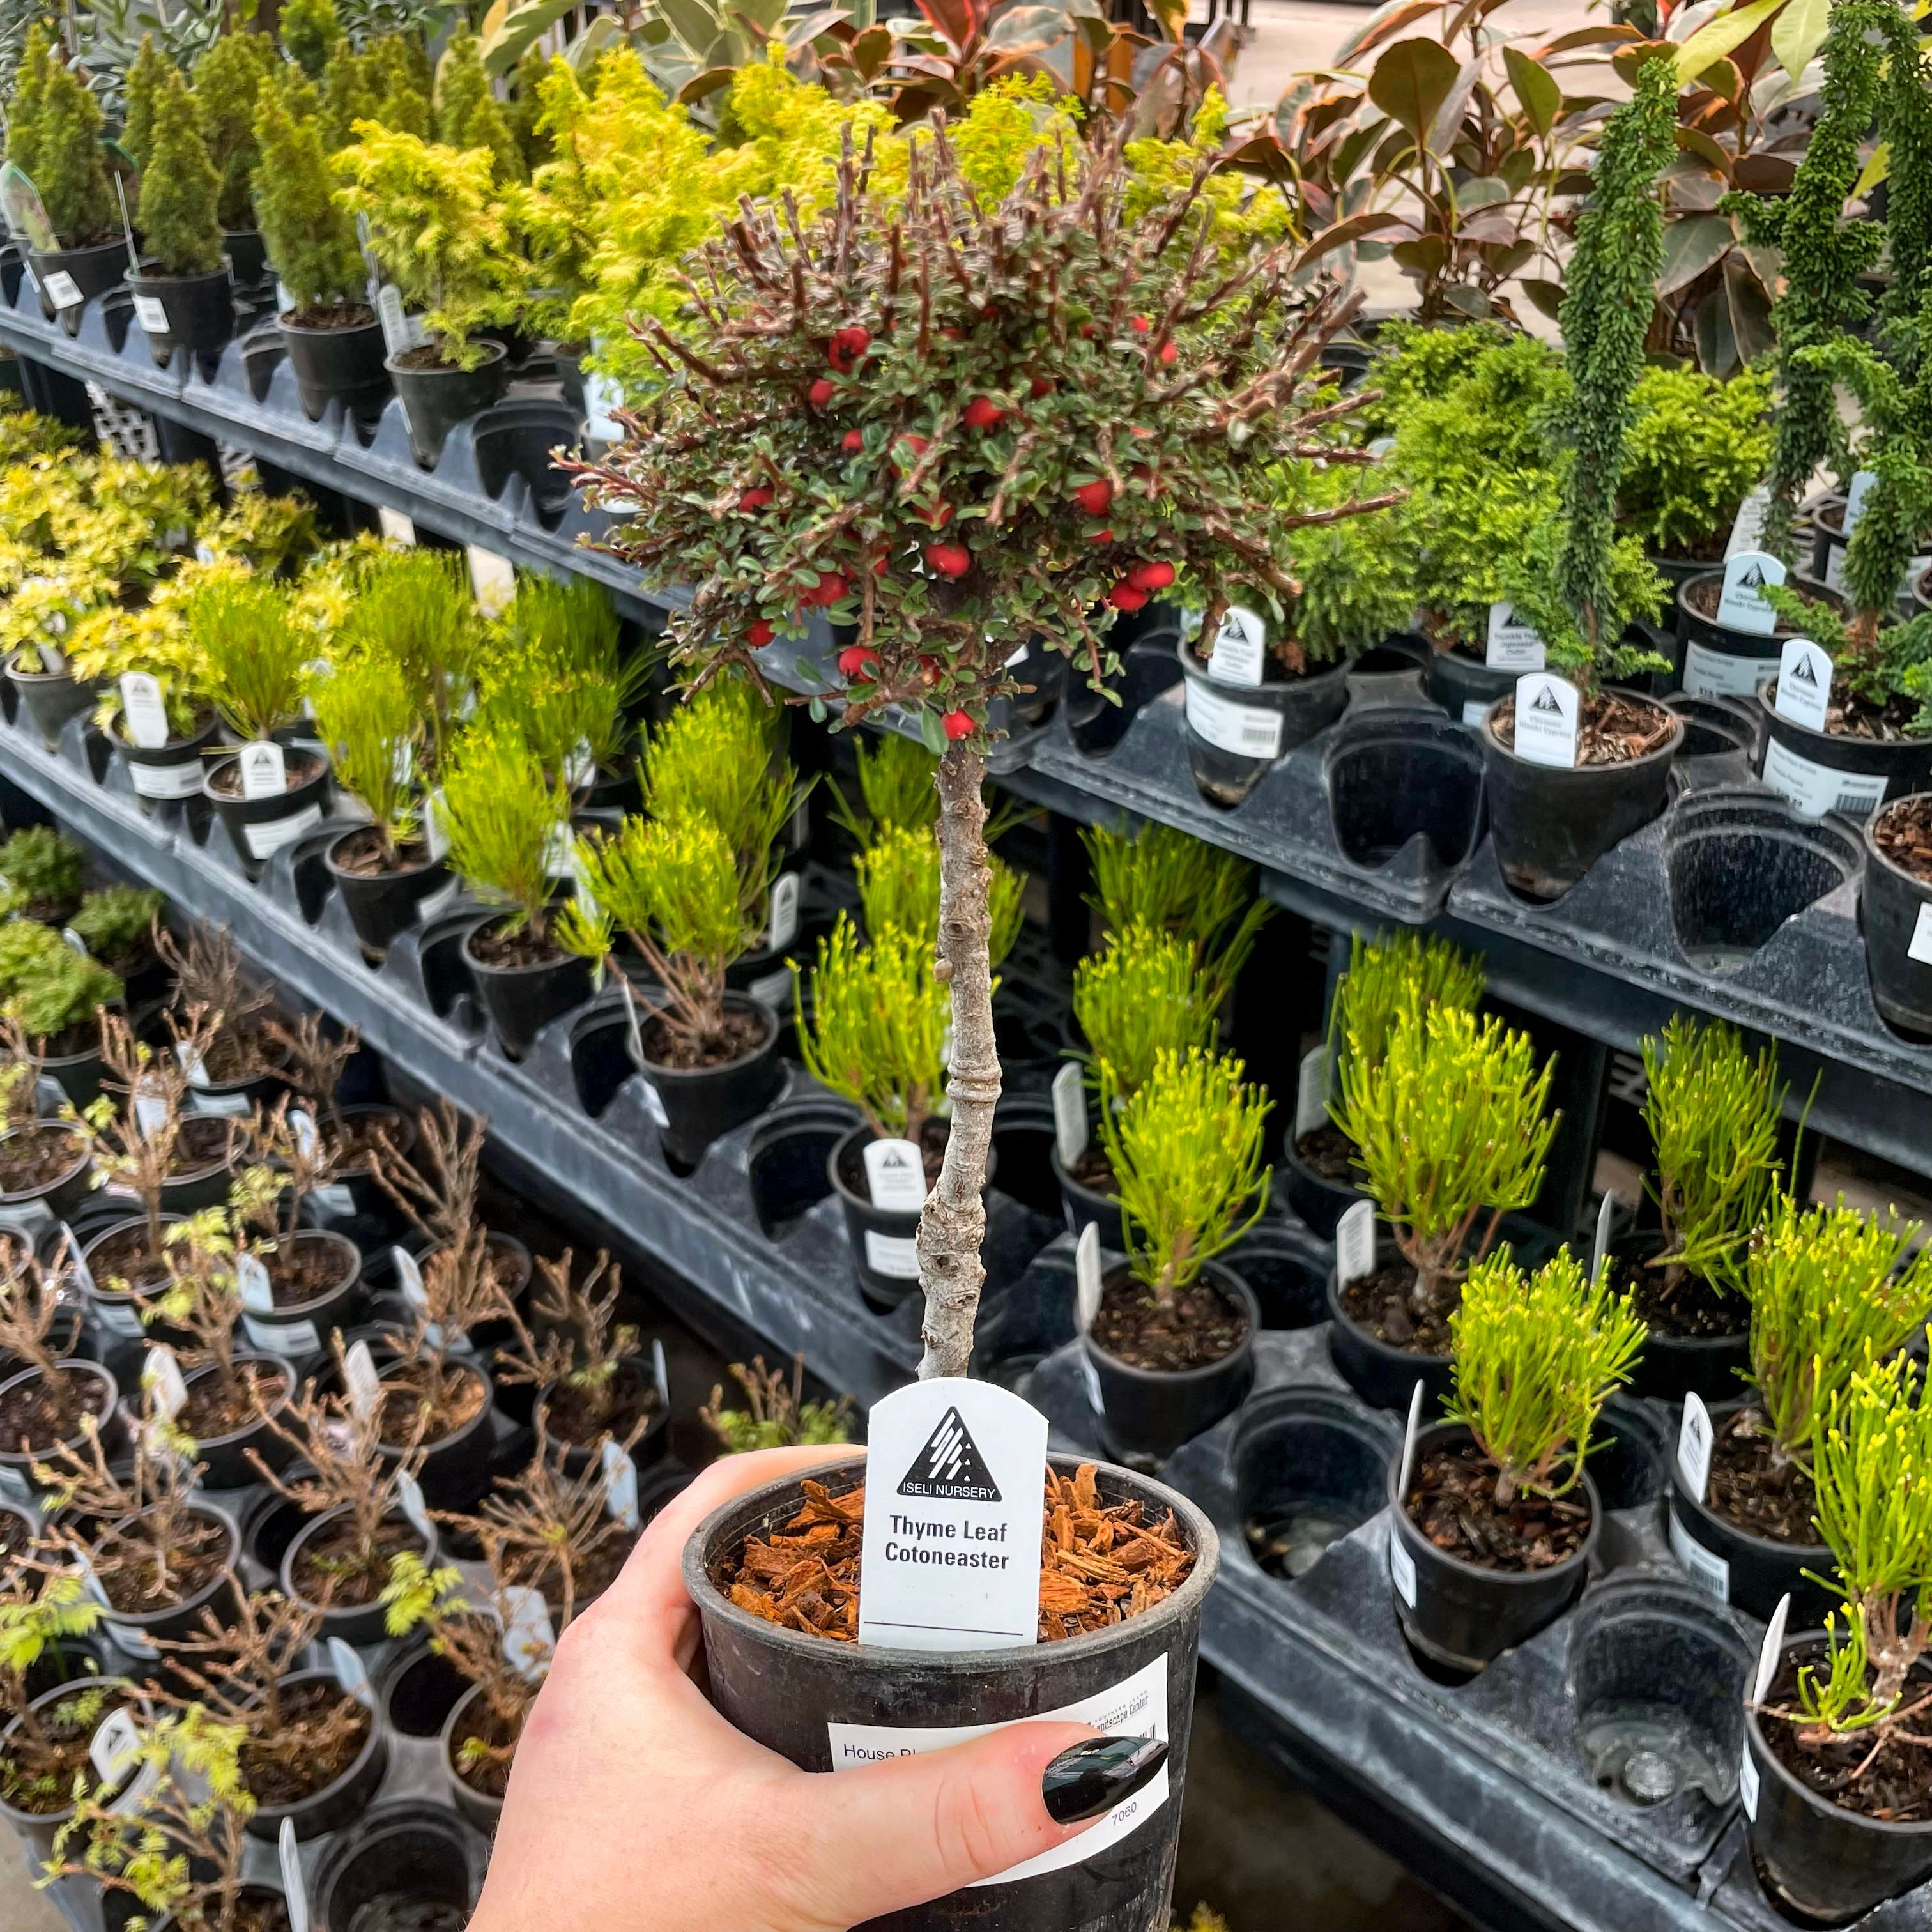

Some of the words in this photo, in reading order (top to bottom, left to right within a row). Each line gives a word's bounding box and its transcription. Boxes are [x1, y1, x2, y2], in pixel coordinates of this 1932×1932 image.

[902, 1482, 933, 1495] ISELI
[935, 1485, 996, 1499] NURSERY
[889, 1514, 956, 1541] Thyme
[963, 1520, 1008, 1542] Leaf
[885, 1542, 1009, 1570] Cotoneaster
[1129, 1695, 1149, 1716] Center
[843, 1744, 896, 1761] House
[1112, 1801, 1137, 1826] 7060
